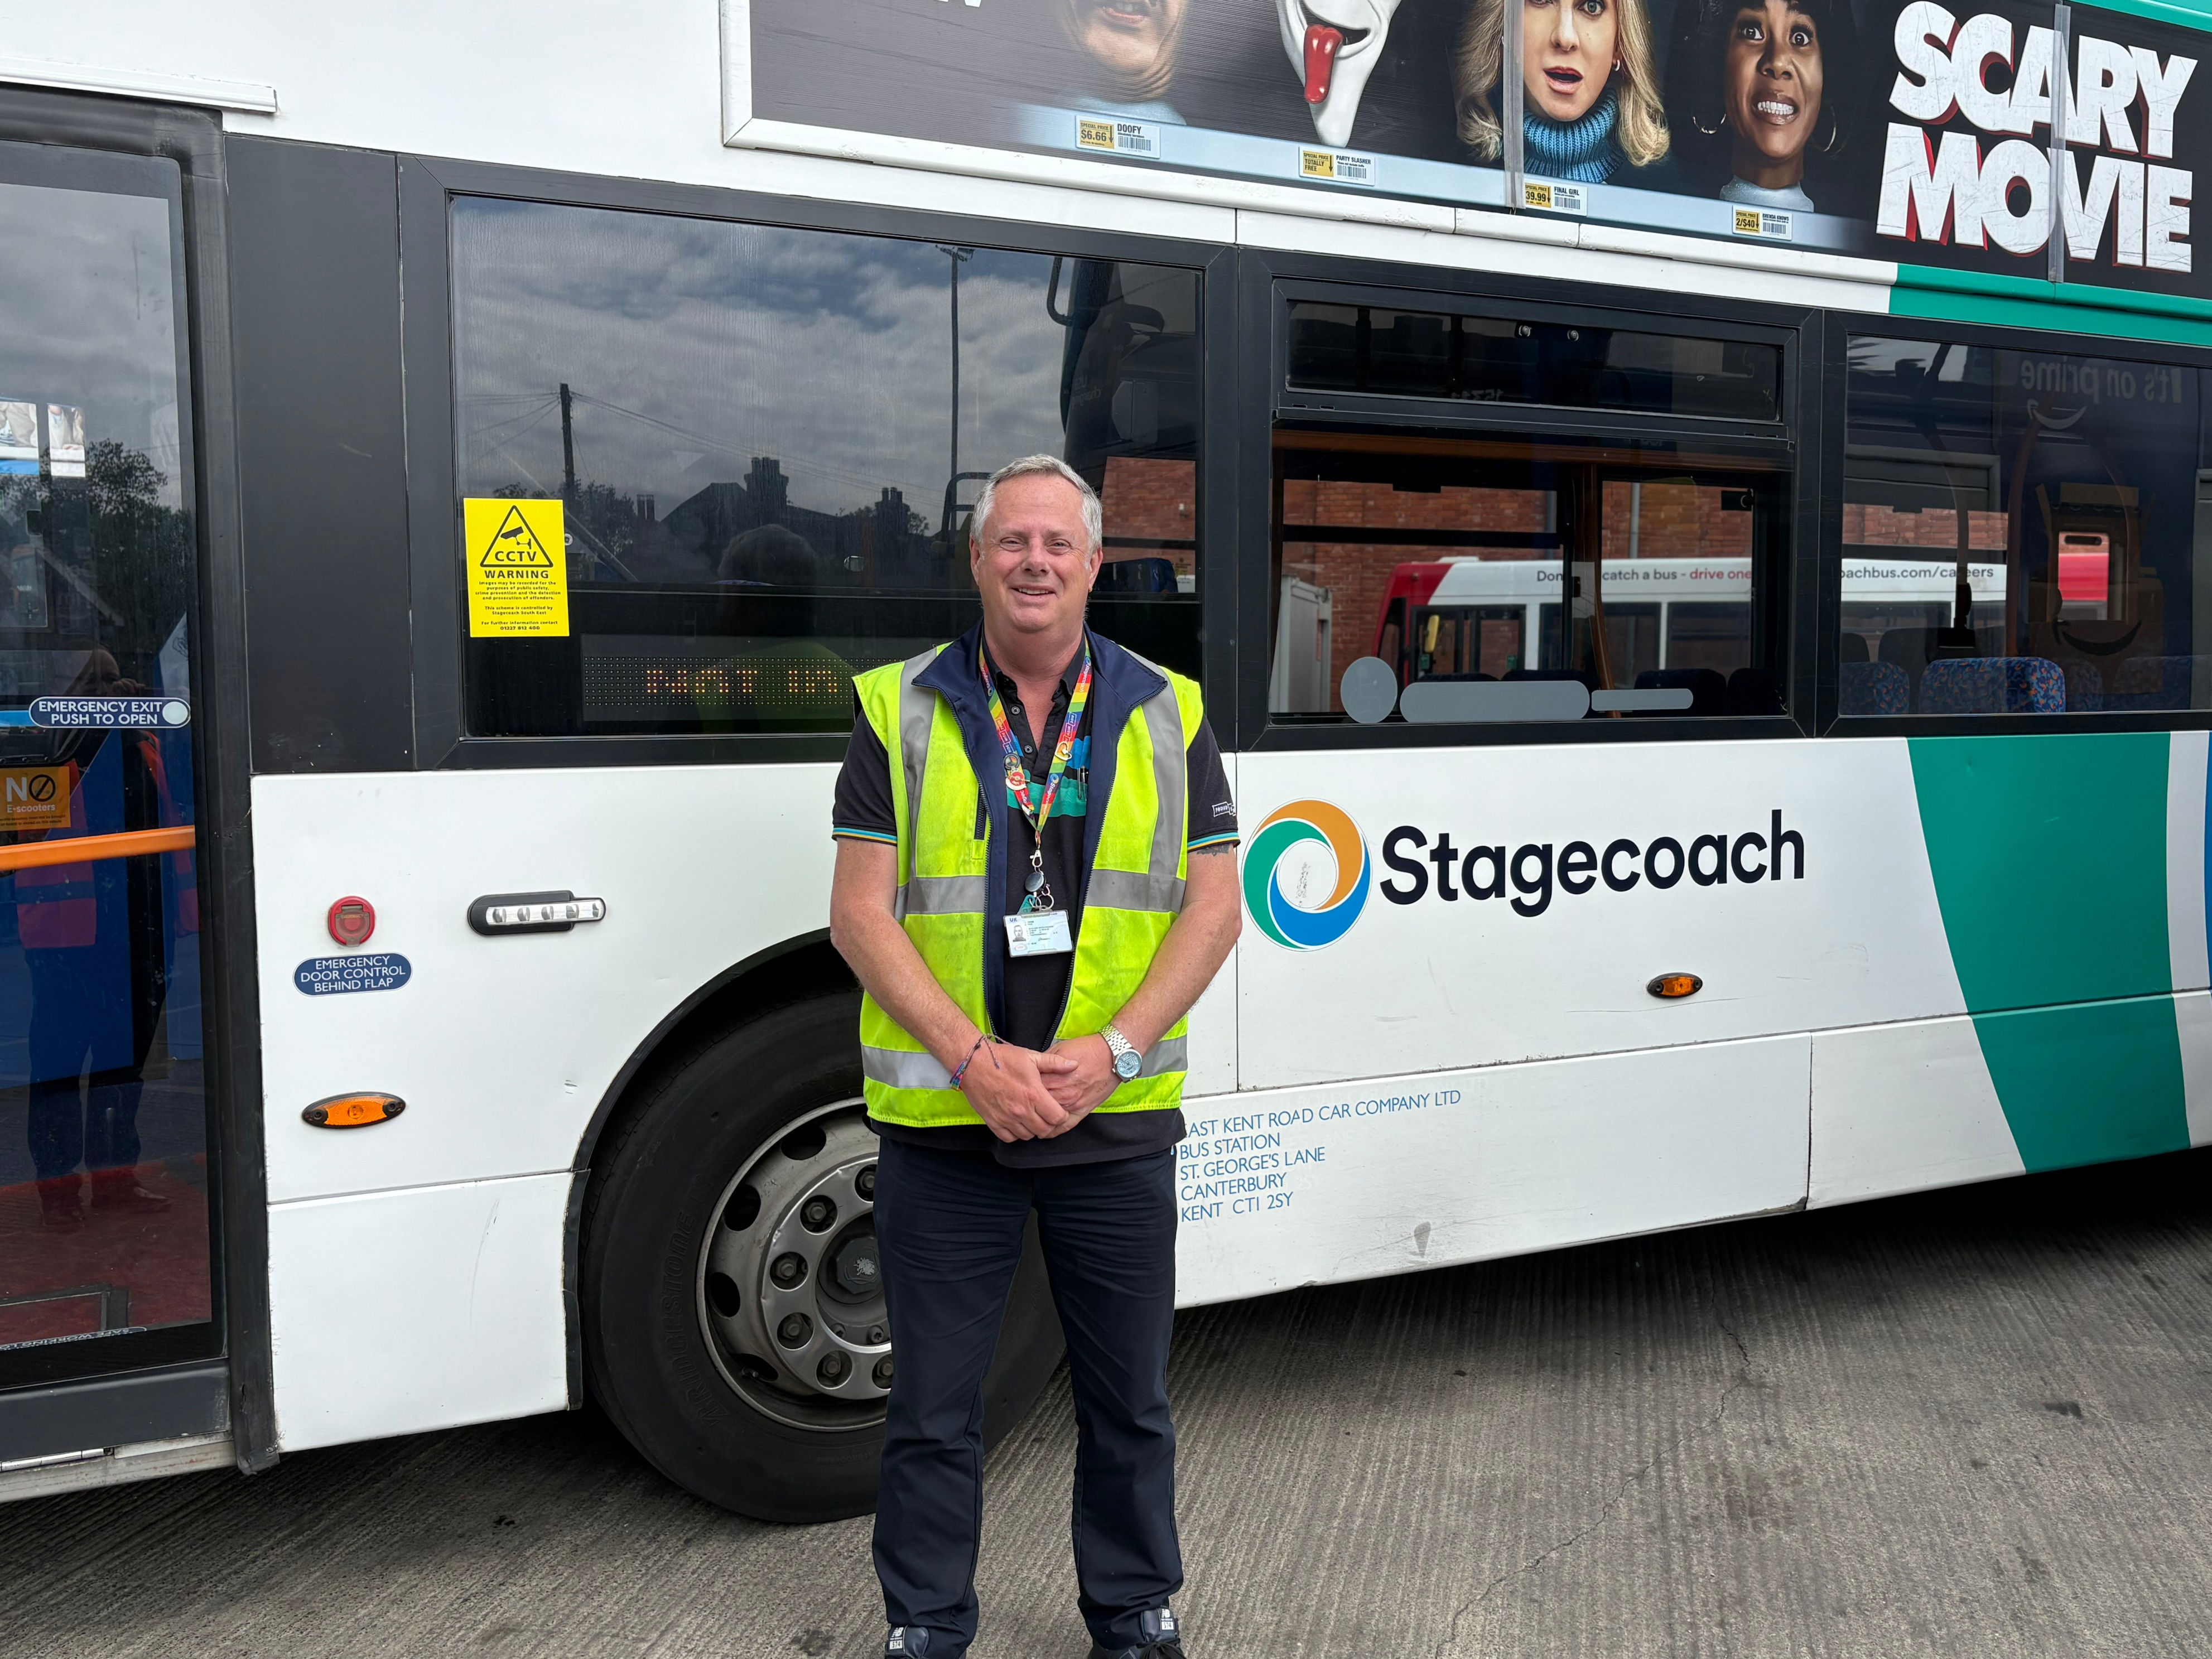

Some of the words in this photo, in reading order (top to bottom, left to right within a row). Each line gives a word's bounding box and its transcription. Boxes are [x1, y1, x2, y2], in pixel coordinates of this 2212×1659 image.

[1889, 1, 2198, 159] SCARY
[1117, 123, 1141, 134] DOOFY
[1081, 129, 1107, 142] $6.66
[1304, 158, 1324, 167] TOTALLY
[1351, 157, 1371, 165] SLASHER
[1525, 191, 1546, 202] 39.99
[1876, 122, 2192, 273] MOVIE
[1736, 218, 1755, 228] 2/$40
[494, 551, 537, 562] CCTV
[484, 570, 549, 578] WARNING
[1536, 570, 1563, 581] Don
[1602, 569, 1639, 581] catch
[1642, 572, 1650, 580] a
[1653, 568, 1678, 580] bus
[1689, 568, 1724, 580] drive
[38, 701, 127, 712] EMERGENCY
[131, 701, 162, 712] EXIT
[51, 713, 89, 725] PUSH
[93, 713, 114, 725] TO
[118, 713, 158, 725] OPEN
[7, 804, 56, 813] E-scooters
[1379, 809, 1805, 918] Stagecoach
[315, 956, 391, 970] EMERGENCY
[301, 971, 340, 982] DOOR
[343, 966, 406, 980] CONTROL
[314, 980, 362, 992] BEHIND
[365, 977, 393, 989] FLAP
[1185, 1120, 1218, 1138] AST
[1223, 1113, 1264, 1134] KENT
[1269, 1108, 1314, 1127] ROAD
[1318, 1103, 1351, 1122] CAR
[1355, 1093, 1430, 1117] COMPANY
[1434, 1089, 1461, 1106] LTD
[1180, 1141, 1209, 1160] BUS
[1214, 1132, 1280, 1156] STATION
[1180, 1163, 1200, 1181] ST.
[1203, 1152, 1279, 1178] GEORGE'S
[1284, 1146, 1326, 1166] LANE
[1180, 1171, 1287, 1201] CANTERBURY
[1181, 1201, 1223, 1222] KENT
[1267, 1191, 1294, 1210] 2SY
[22, 1333, 92, 1346] WORKING
